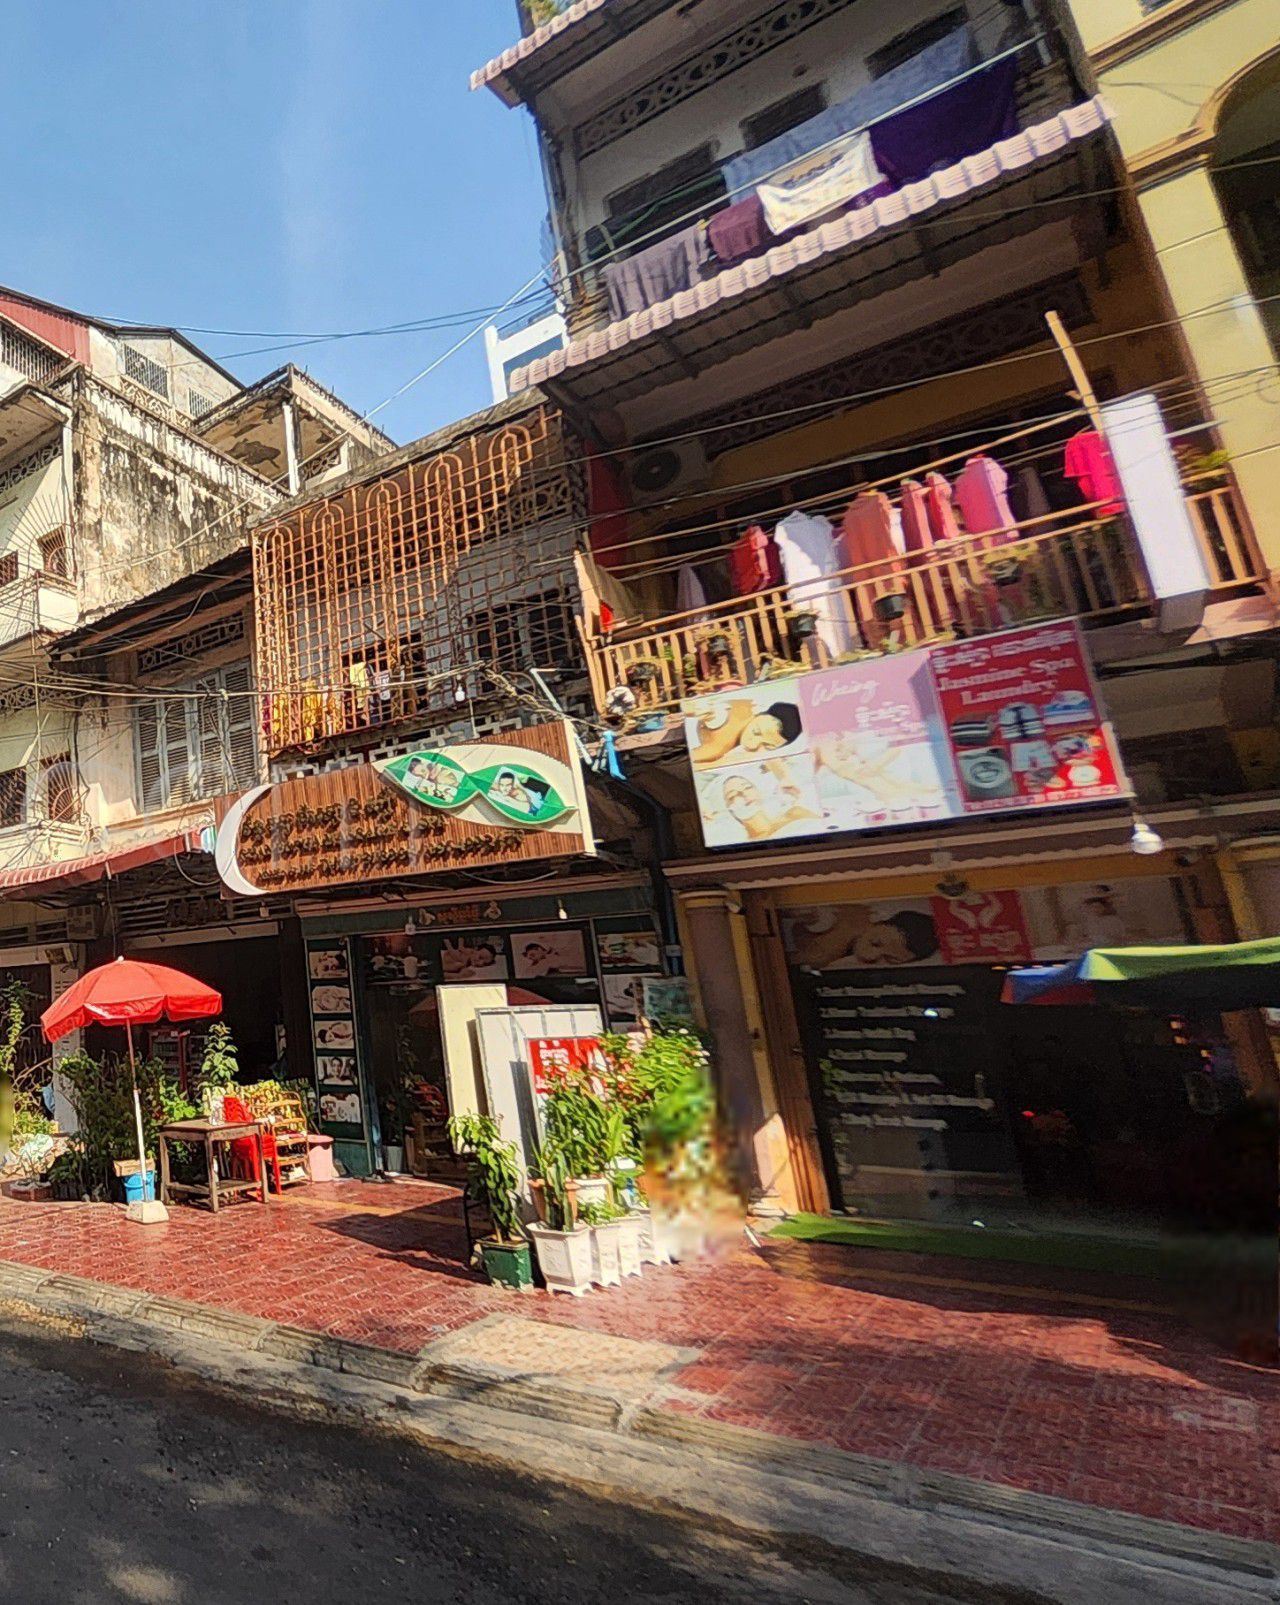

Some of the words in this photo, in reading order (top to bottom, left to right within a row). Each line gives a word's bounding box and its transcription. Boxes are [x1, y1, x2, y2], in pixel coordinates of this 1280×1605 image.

[937, 666, 1027, 691] Jasmine
[1029, 658, 1077, 677] Spa
[961, 680, 1057, 705] Laundry
